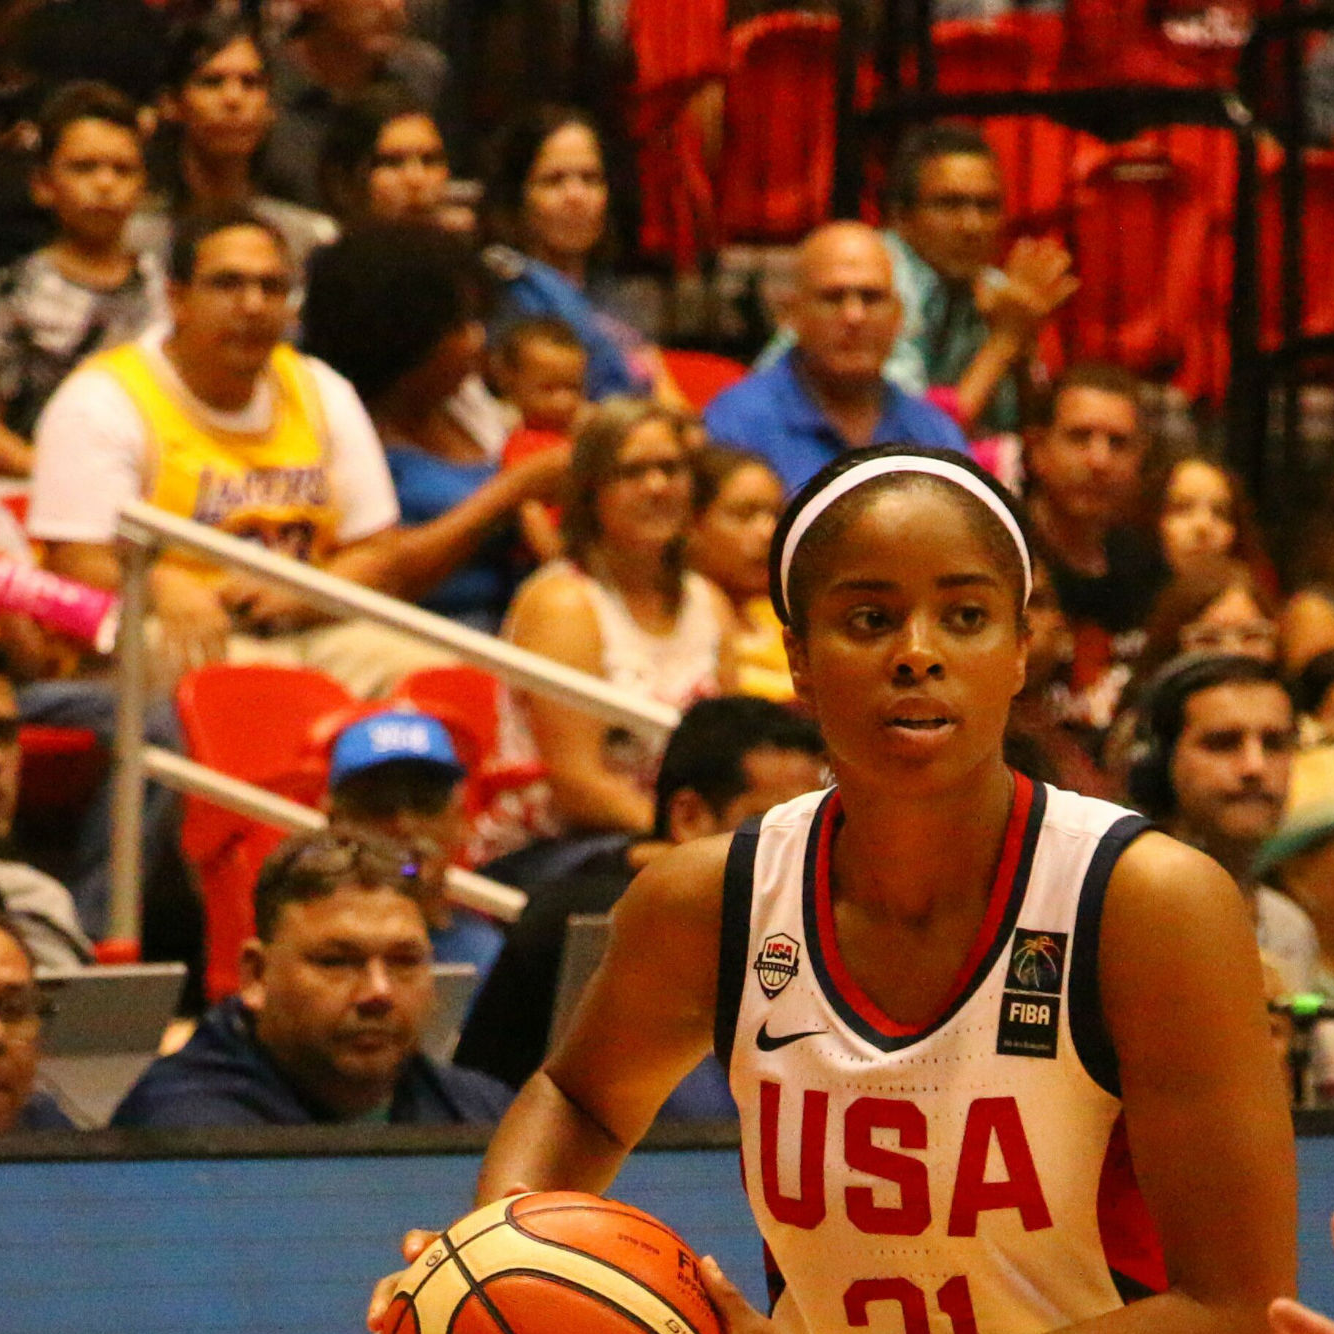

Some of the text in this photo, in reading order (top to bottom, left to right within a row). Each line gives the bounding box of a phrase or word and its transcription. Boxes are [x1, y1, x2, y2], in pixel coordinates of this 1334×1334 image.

[766, 942, 793, 963] USA
[1009, 1002, 1051, 1025] FIBA
[760, 1080, 1054, 1237] USA
